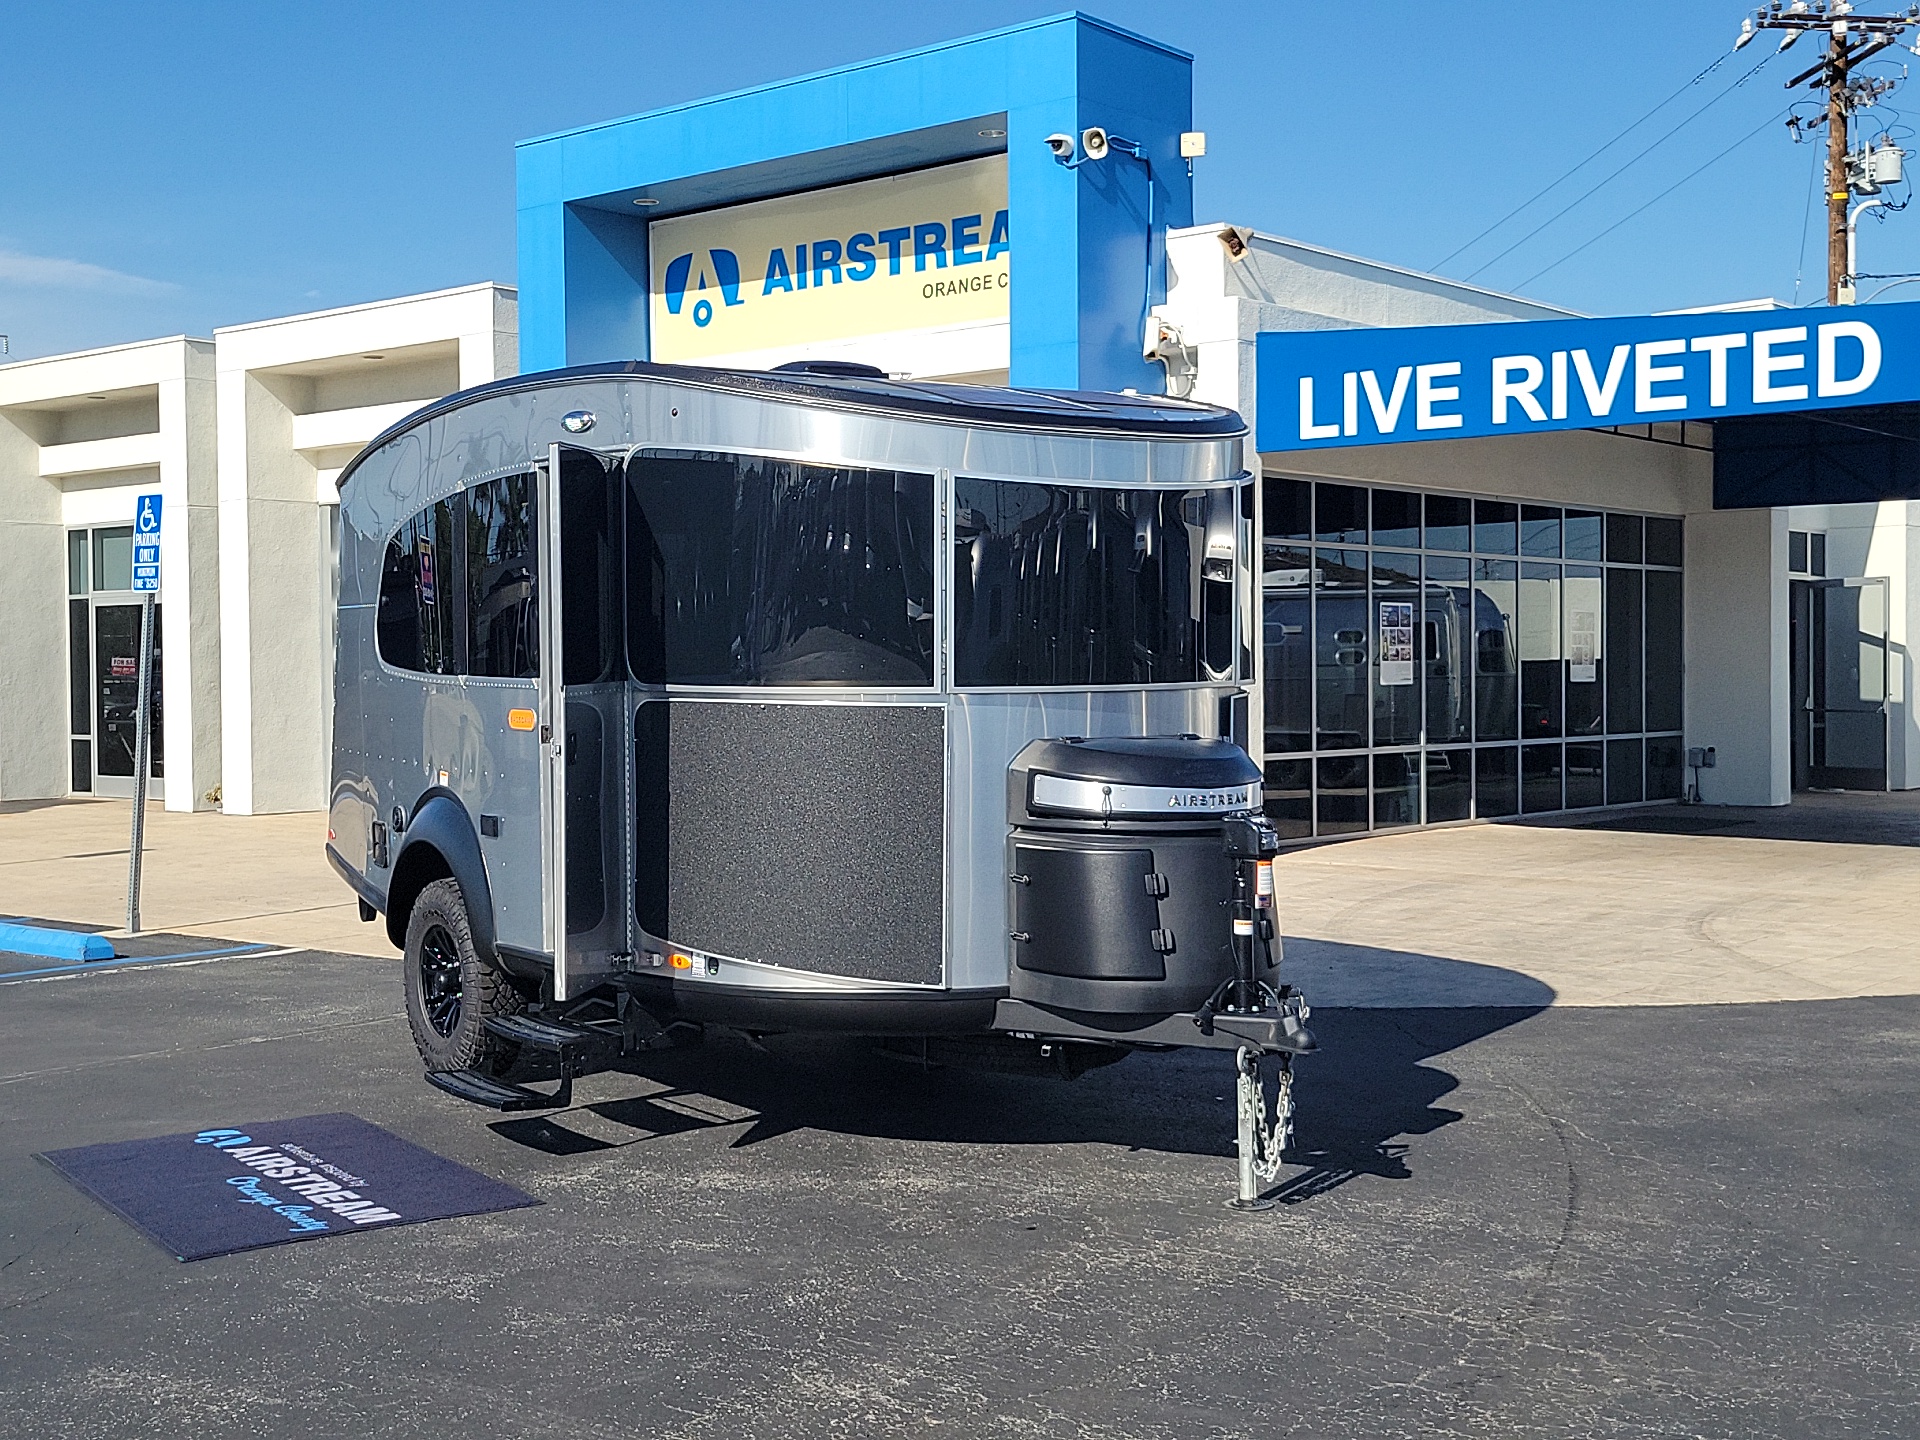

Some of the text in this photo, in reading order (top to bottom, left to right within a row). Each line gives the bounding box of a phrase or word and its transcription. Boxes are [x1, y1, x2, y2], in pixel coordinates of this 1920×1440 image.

[922, 275, 993, 299] ORANGE
[1299, 320, 1883, 440] LIVE RIVETED
[135, 532, 160, 546] PARKING
[138, 548, 155, 562] ONLY
[222, 1145, 402, 1225] AIRSTREAM
[226, 1175, 330, 1232] Orange County
